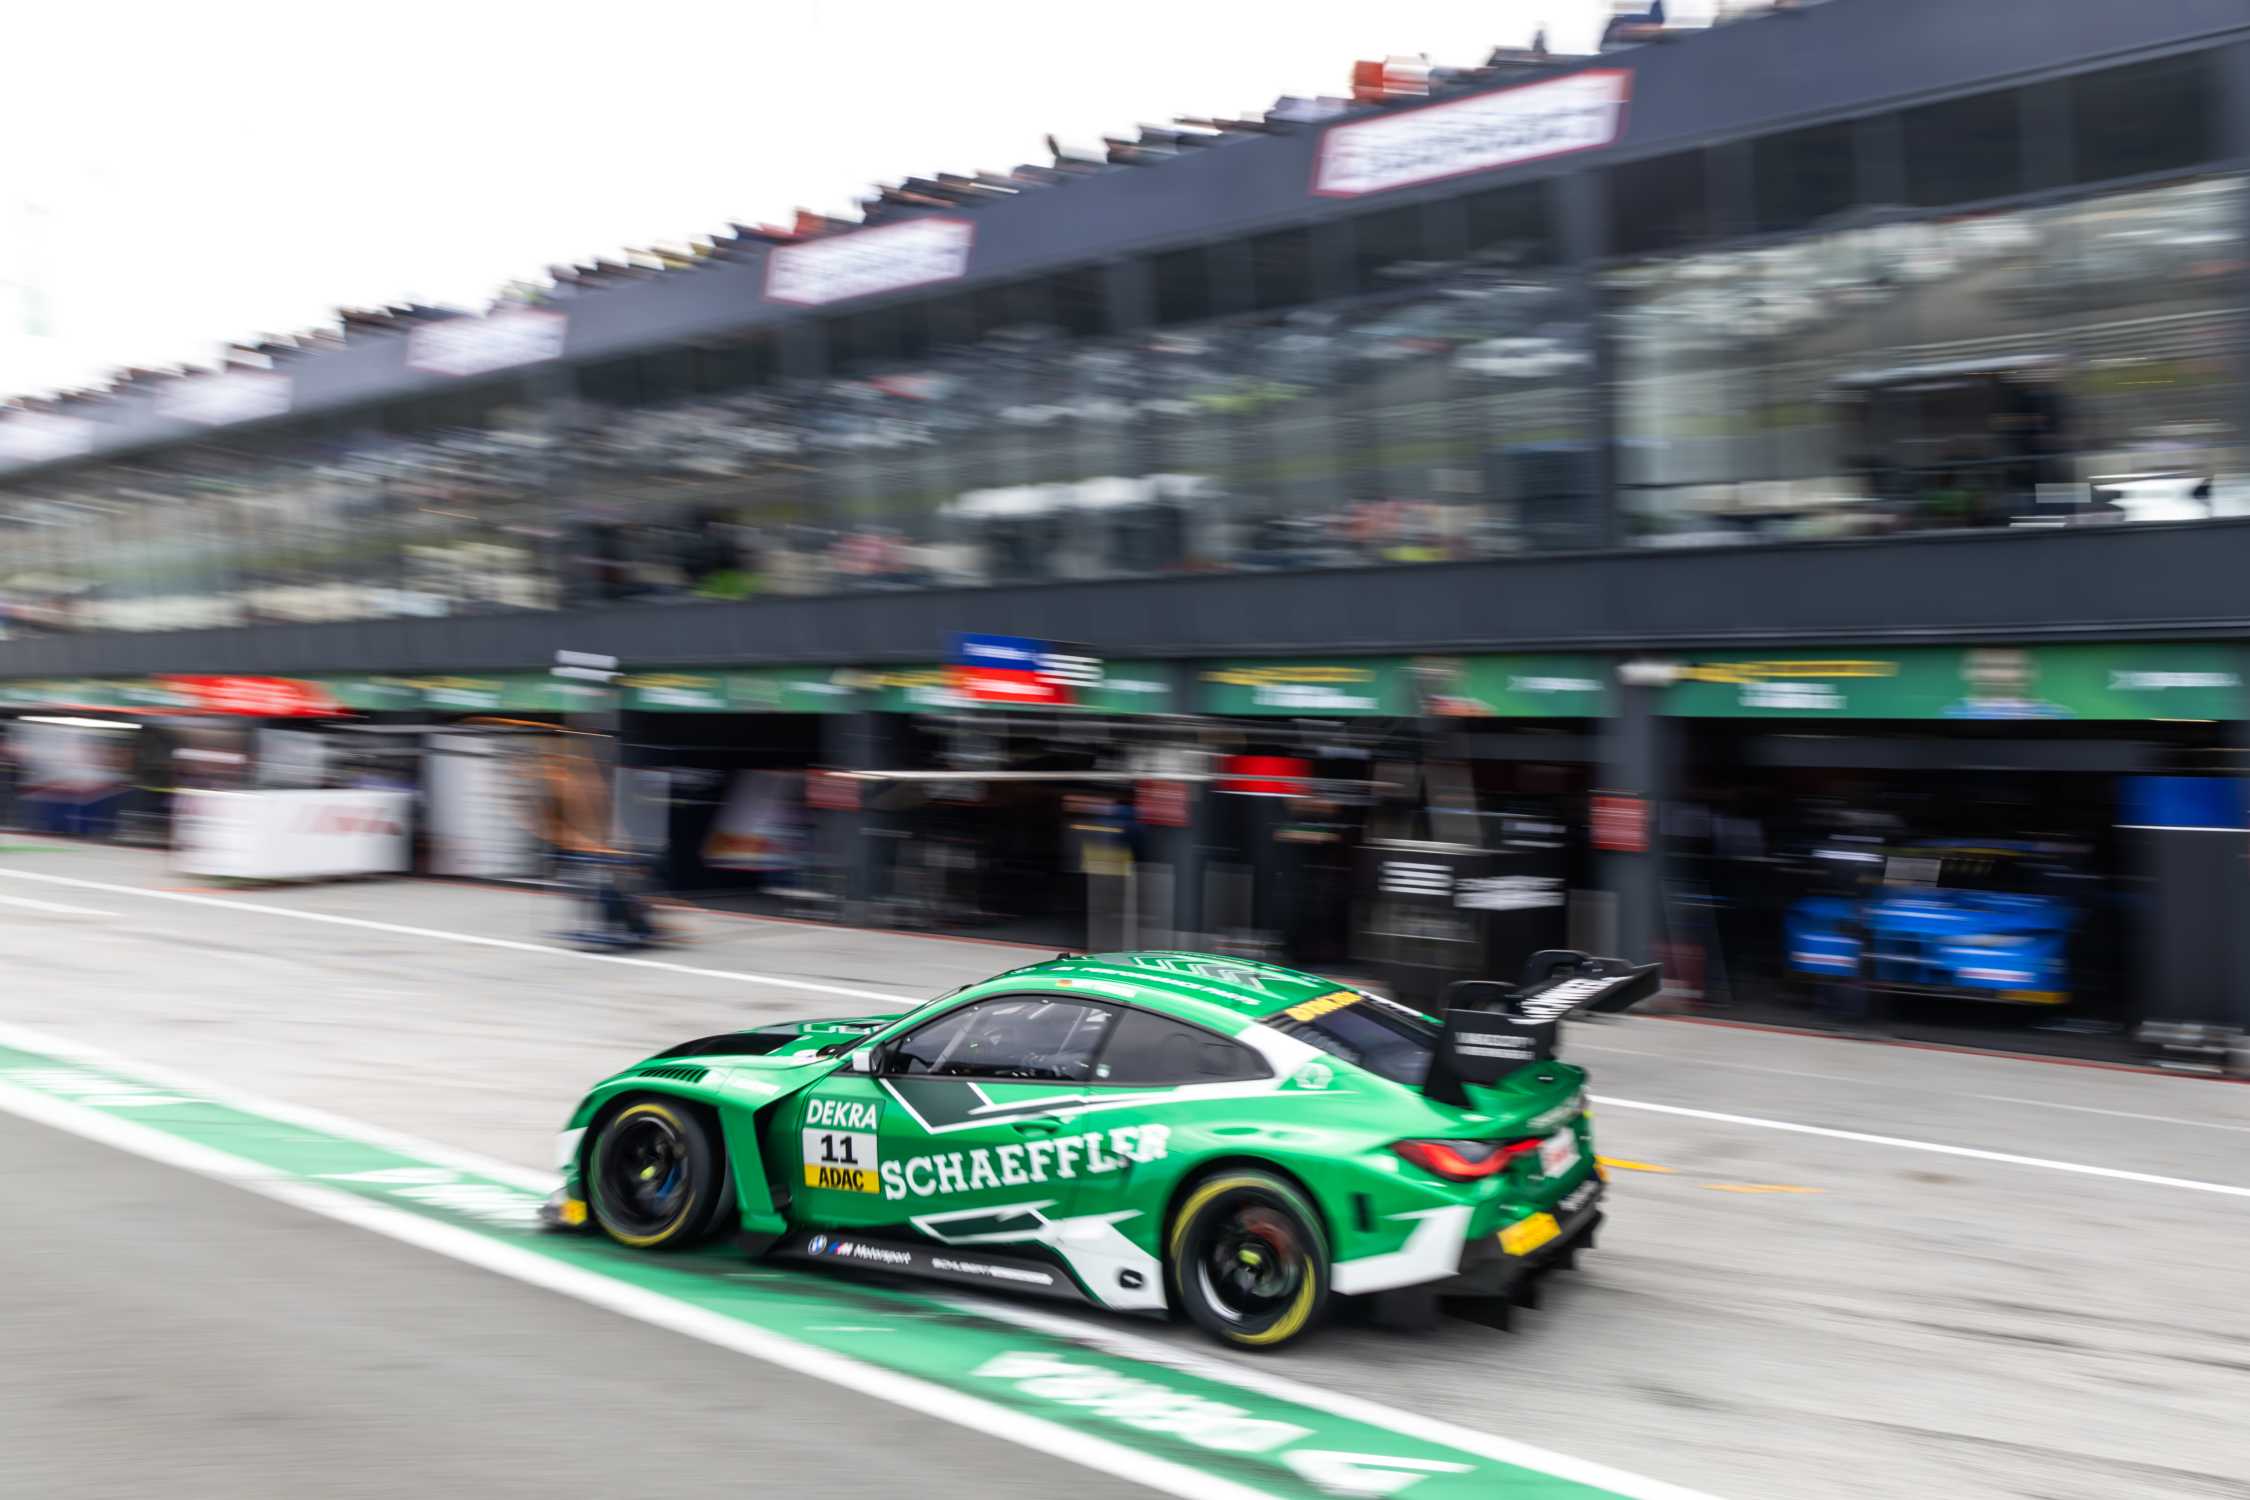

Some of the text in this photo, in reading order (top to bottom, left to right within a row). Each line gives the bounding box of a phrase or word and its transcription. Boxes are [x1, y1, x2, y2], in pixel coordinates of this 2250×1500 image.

[806, 1098, 877, 1130] DEKRA
[820, 1133, 858, 1165] 11
[880, 1123, 1170, 1201] SCHAEFFLER
[819, 1166, 865, 1191] ADAC
